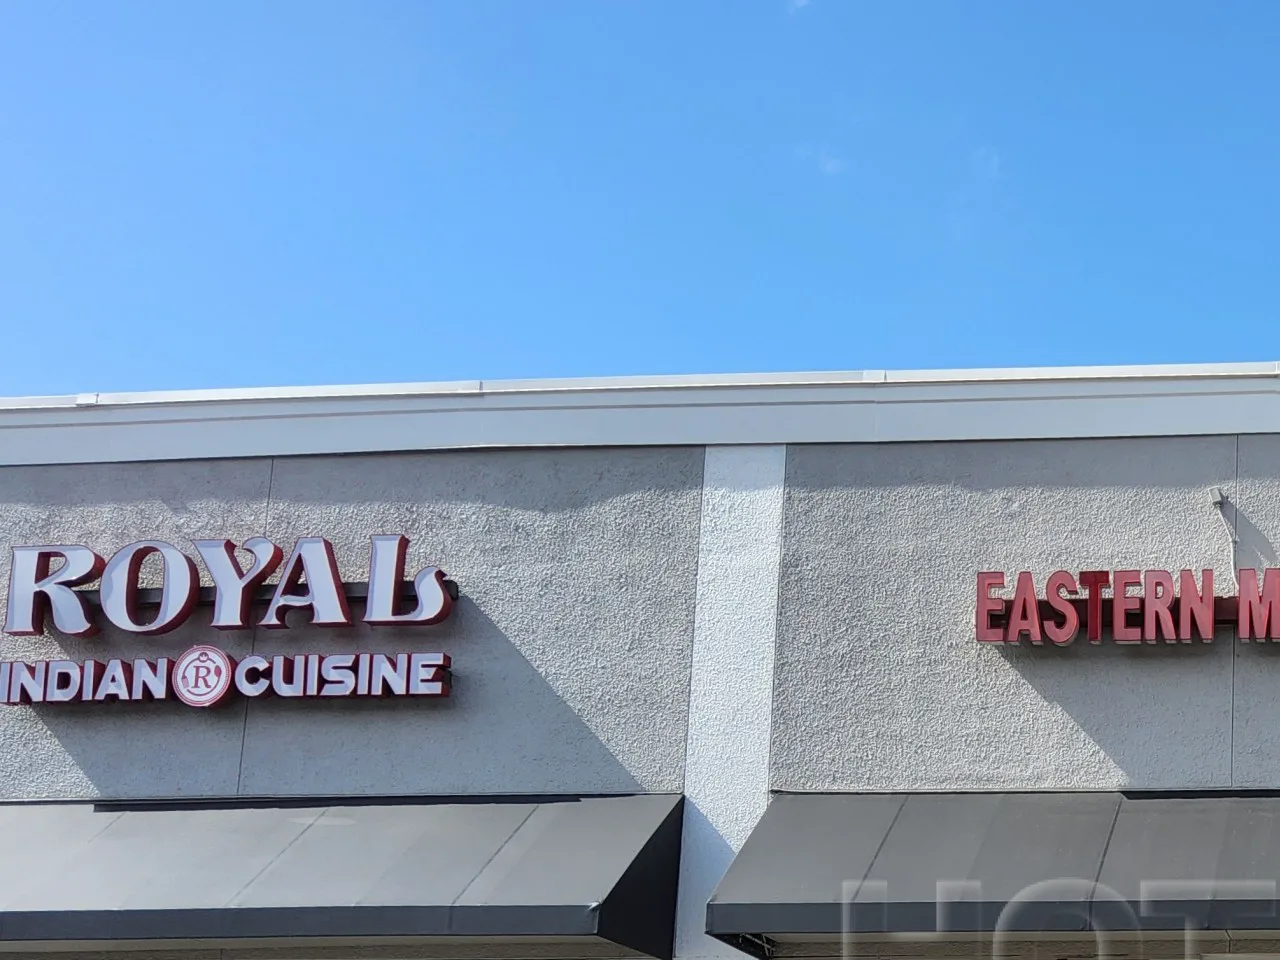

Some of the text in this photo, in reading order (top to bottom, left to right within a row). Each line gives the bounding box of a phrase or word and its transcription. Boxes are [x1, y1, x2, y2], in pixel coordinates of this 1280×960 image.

[2, 535, 453, 638] ROYAL
[976, 567, 1215, 645] EASTERN
[0, 657, 173, 704] INDIAN
[234, 652, 451, 698] CUISINE
